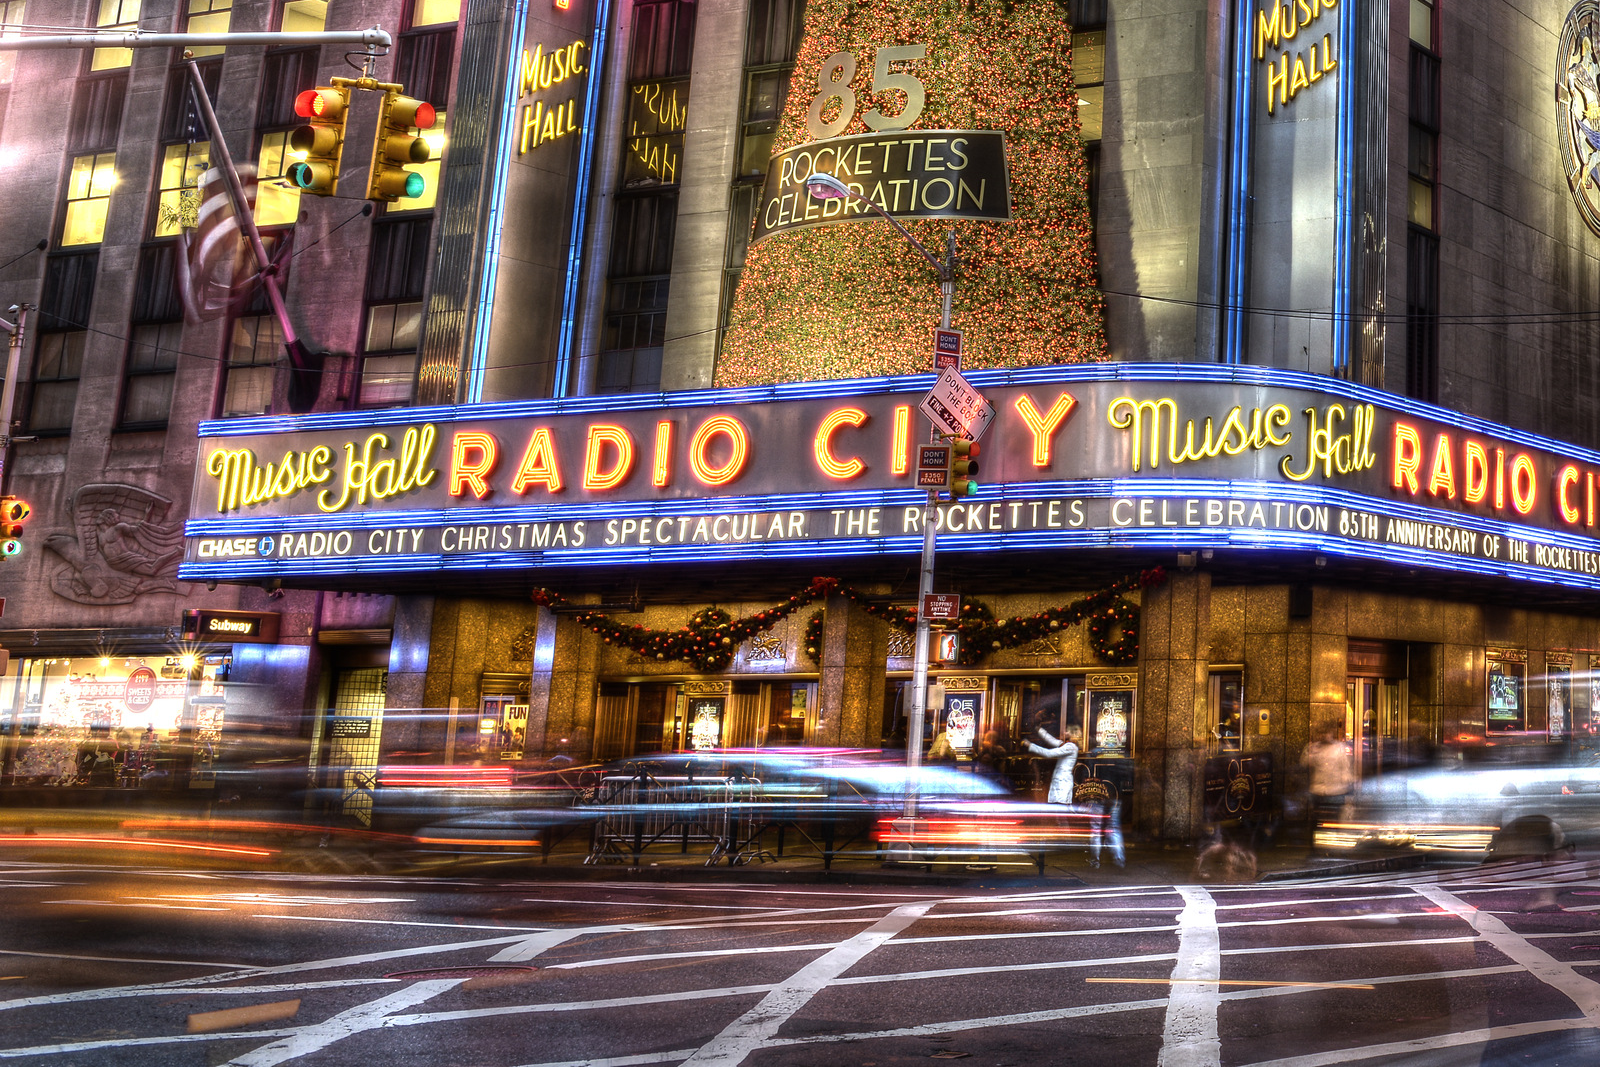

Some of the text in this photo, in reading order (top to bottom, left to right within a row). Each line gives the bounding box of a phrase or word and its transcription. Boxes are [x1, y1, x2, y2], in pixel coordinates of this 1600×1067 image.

[519, 40, 584, 99] MUSIC
[805, 44, 927, 139] 85
[1266, 33, 1338, 116] HALL
[519, 99, 577, 155] HALL
[779, 137, 969, 190] ROCKETTES
[940, 334, 958, 343] DON'T
[940, 342, 957, 350] HONK
[928, 397, 974, 441] FINE +2 POINTS
[944, 374, 989, 422] DON'T BLOCK
[946, 391, 976, 424] THE BOX
[205, 389, 1376, 514] Music Hall RADIO CIY Music Hall
[1391, 421, 1538, 516] RADIO
[198, 538, 258, 557] CHASE
[278, 498, 1329, 557] RADIO CITY CHRISTMAS SPECTACULAR. THE ROCKETTES CELEBRATION
[1338, 510, 1379, 541] 85TH
[1385, 519, 1478, 558] ANNIVERSARY
[1482, 534, 1501, 559] OF
[1507, 538, 1529, 565] THE
[209, 618, 252, 634] Subway
[128, 688, 152, 696] SWEETS
[132, 696, 150, 704] GIFTS
[508, 706, 528, 720] FUN
